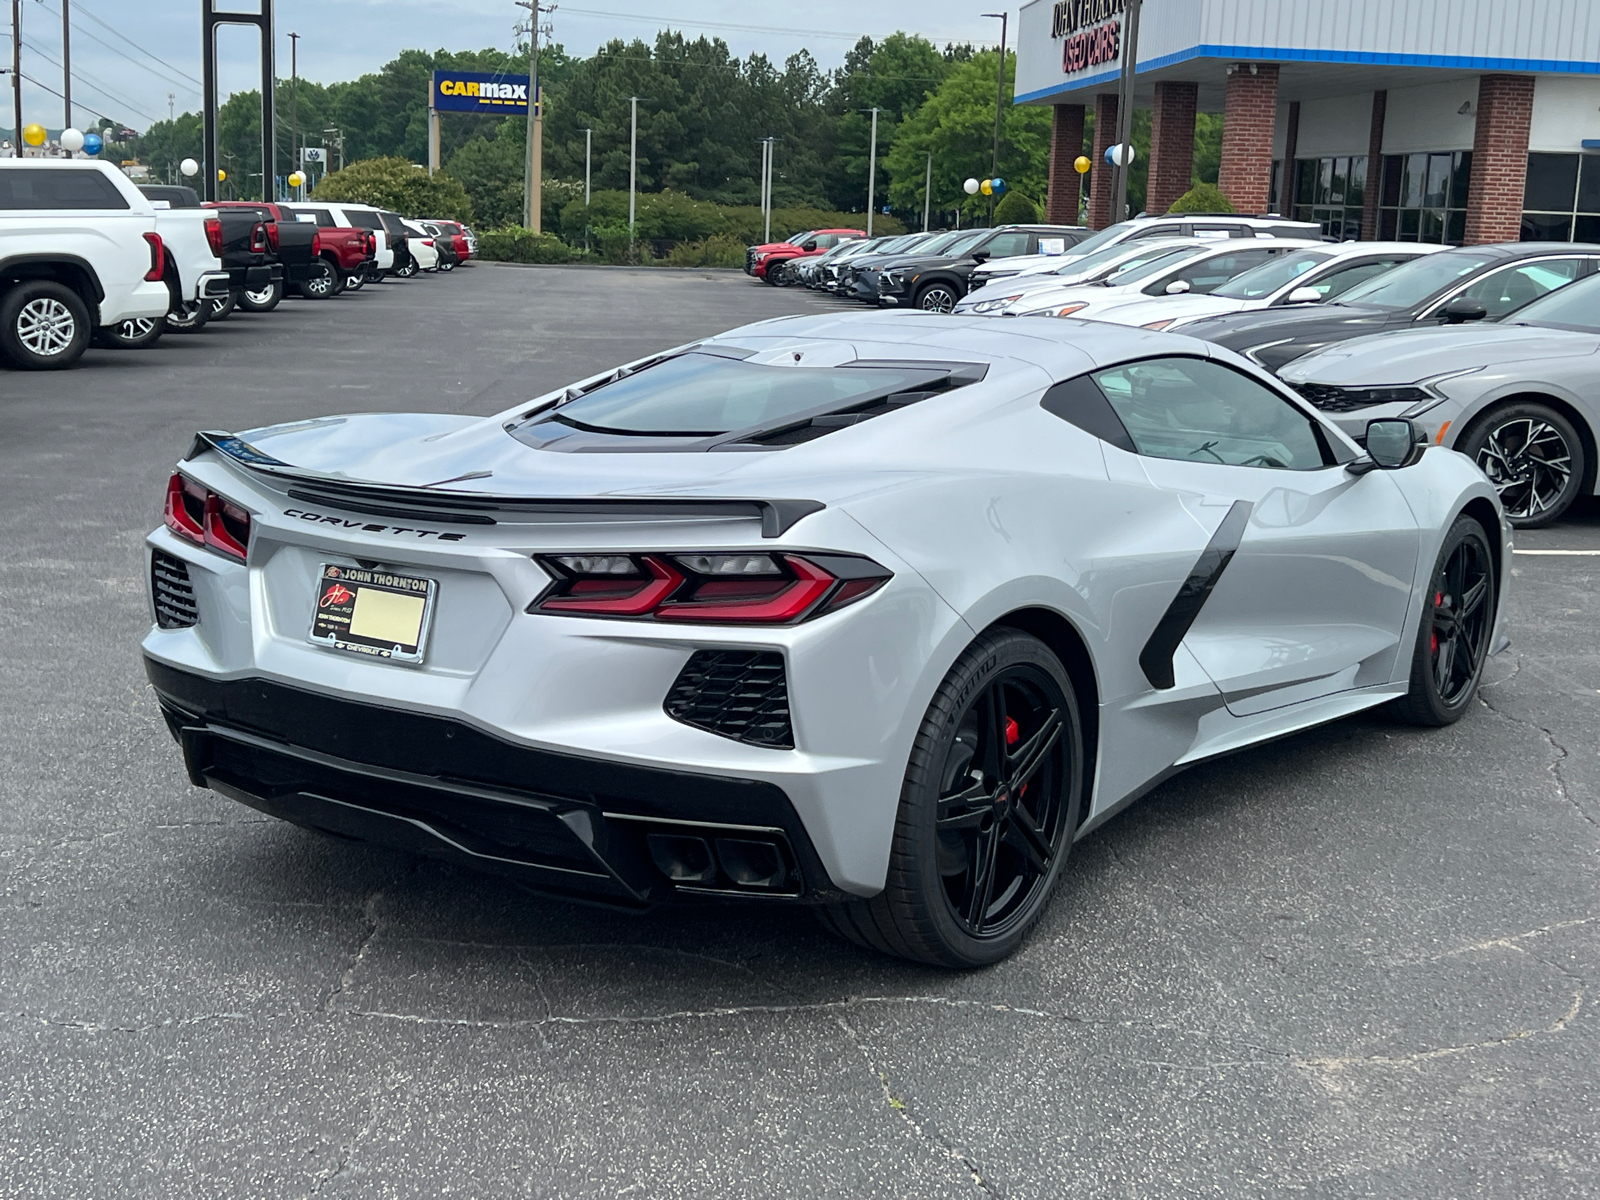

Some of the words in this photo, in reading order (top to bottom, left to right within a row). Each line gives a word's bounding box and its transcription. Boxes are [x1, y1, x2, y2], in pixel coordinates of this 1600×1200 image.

[1051, 0, 1077, 38] JOHN
[1062, 32, 1087, 74] USED
[1087, 20, 1119, 66] CARS
[283, 508, 467, 541] CORVETTE
[344, 568, 371, 583] JOHN
[373, 573, 427, 591] THORNTON
[346, 644, 380, 655] CHEVROLET
